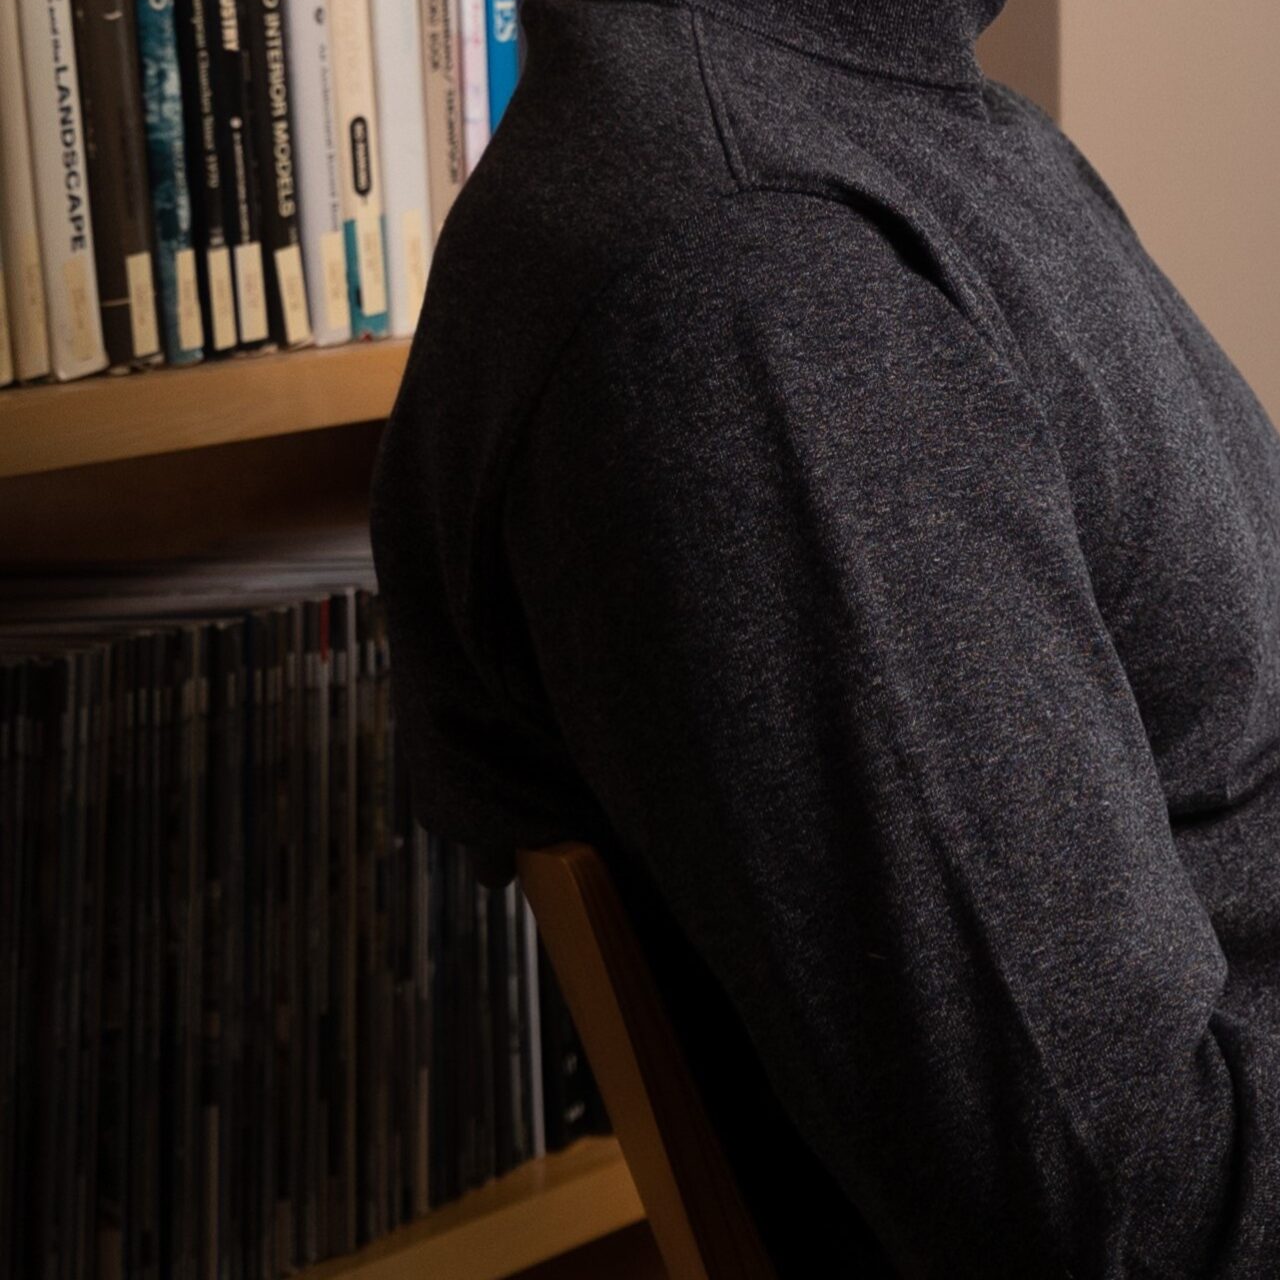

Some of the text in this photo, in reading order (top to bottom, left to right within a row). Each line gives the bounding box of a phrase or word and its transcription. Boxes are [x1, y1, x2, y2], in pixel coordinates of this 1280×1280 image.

[264, 13, 289, 116] INTERIOR
[54, 66, 87, 253] LANDSCAPE
[274, 122, 298, 217] MODELS
